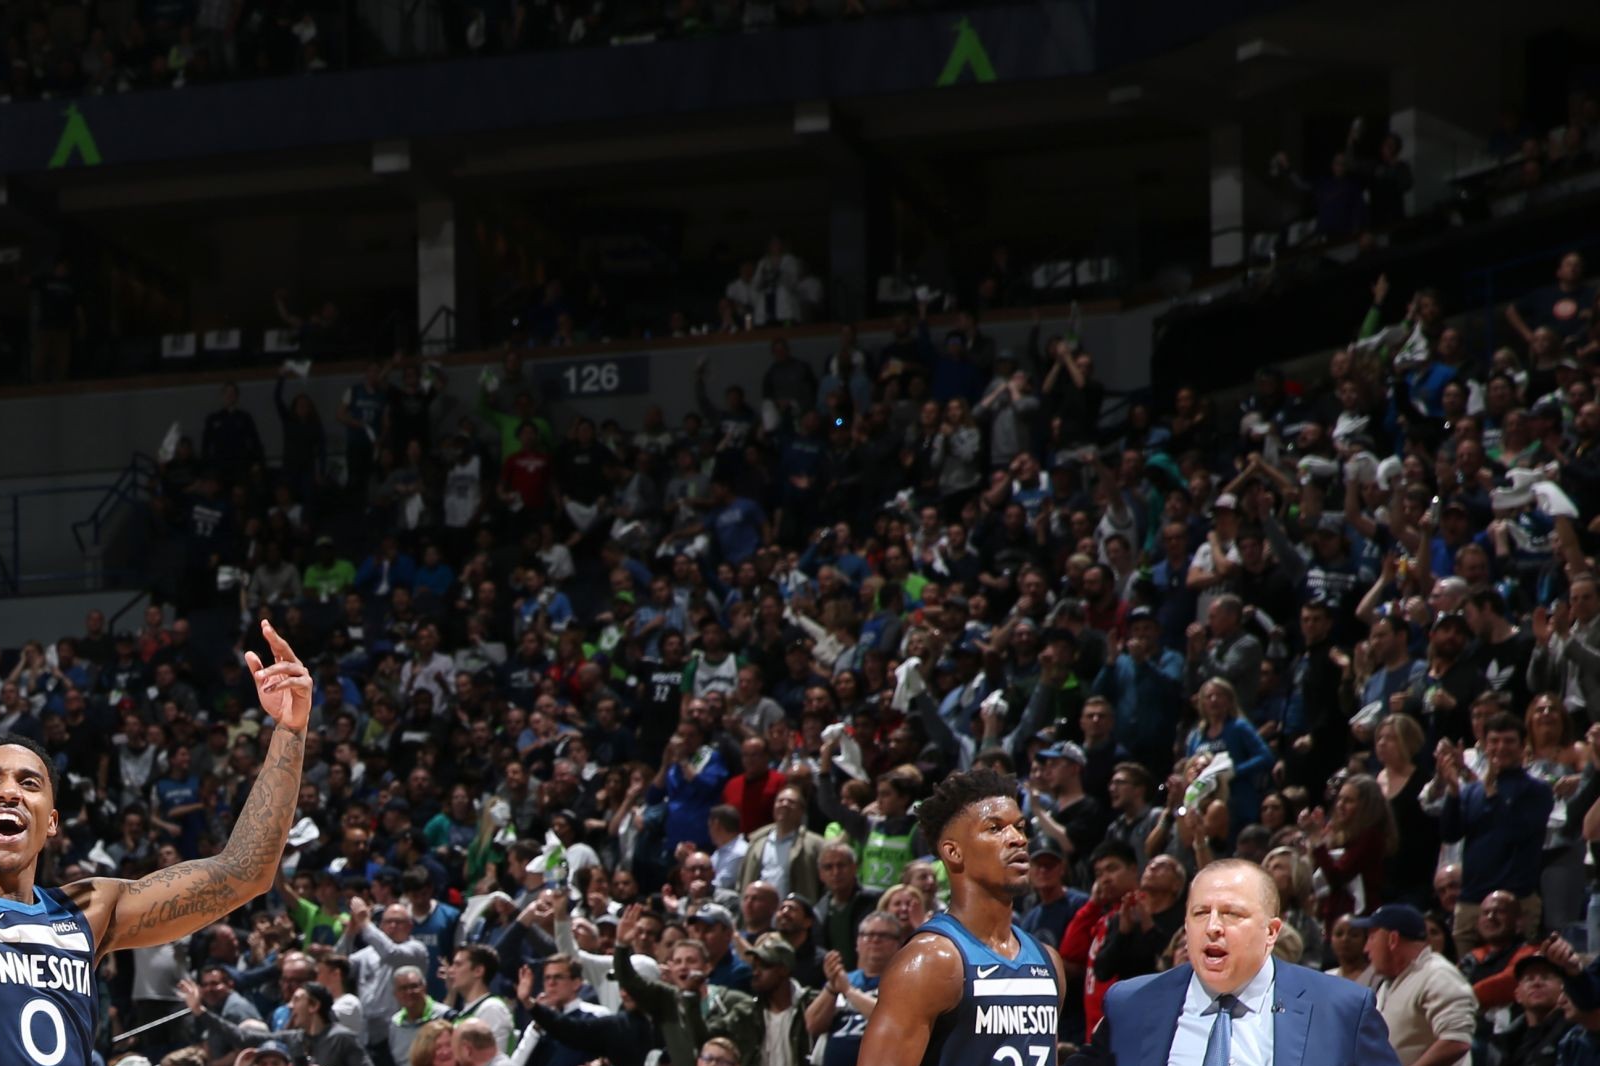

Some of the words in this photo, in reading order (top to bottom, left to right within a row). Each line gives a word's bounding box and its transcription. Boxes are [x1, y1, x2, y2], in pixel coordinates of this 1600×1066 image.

[563, 361, 620, 394] 126
[20, 998, 67, 1066] 0
[974, 1004, 1058, 1035] MINNESOTA
